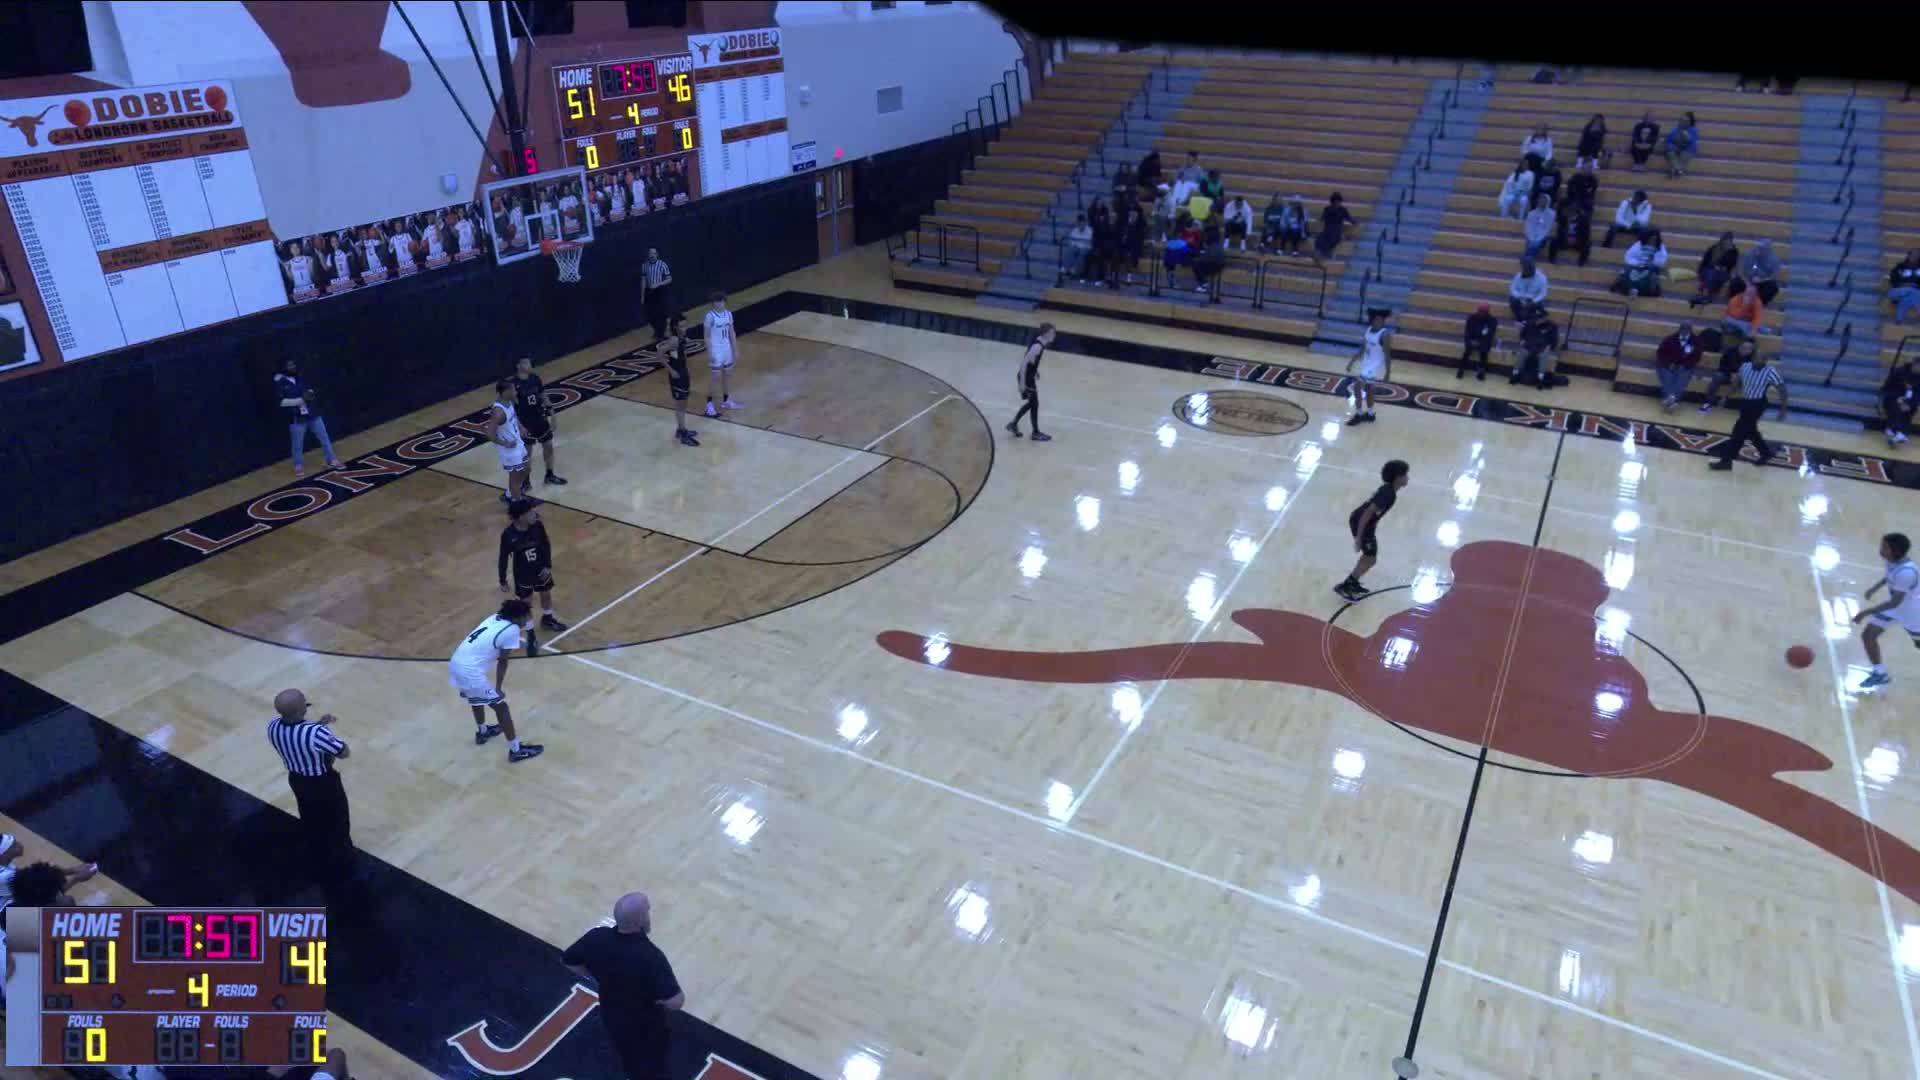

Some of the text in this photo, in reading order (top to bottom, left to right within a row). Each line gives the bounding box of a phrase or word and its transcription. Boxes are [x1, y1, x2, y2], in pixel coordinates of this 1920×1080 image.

[730, 32, 769, 50] DOBIE
[560, 67, 593, 88] HOME
[612, 62, 655, 93] 7:57
[656, 56, 692, 75] VISITOR
[92, 88, 204, 121] DOBIE
[567, 87, 596, 119] 51
[668, 74, 691, 102] 46
[625, 102, 640, 125] 4
[76, 122, 149, 141] LONGHORN
[152, 111, 234, 131] BASKETBALL
[682, 128, 693, 149] 0
[586, 145, 599, 169] 0
[1201, 356, 1481, 415] DOBIE
[527, 394, 537, 406] 13
[525, 548, 537, 562] 15
[468, 627, 488, 644] 4
